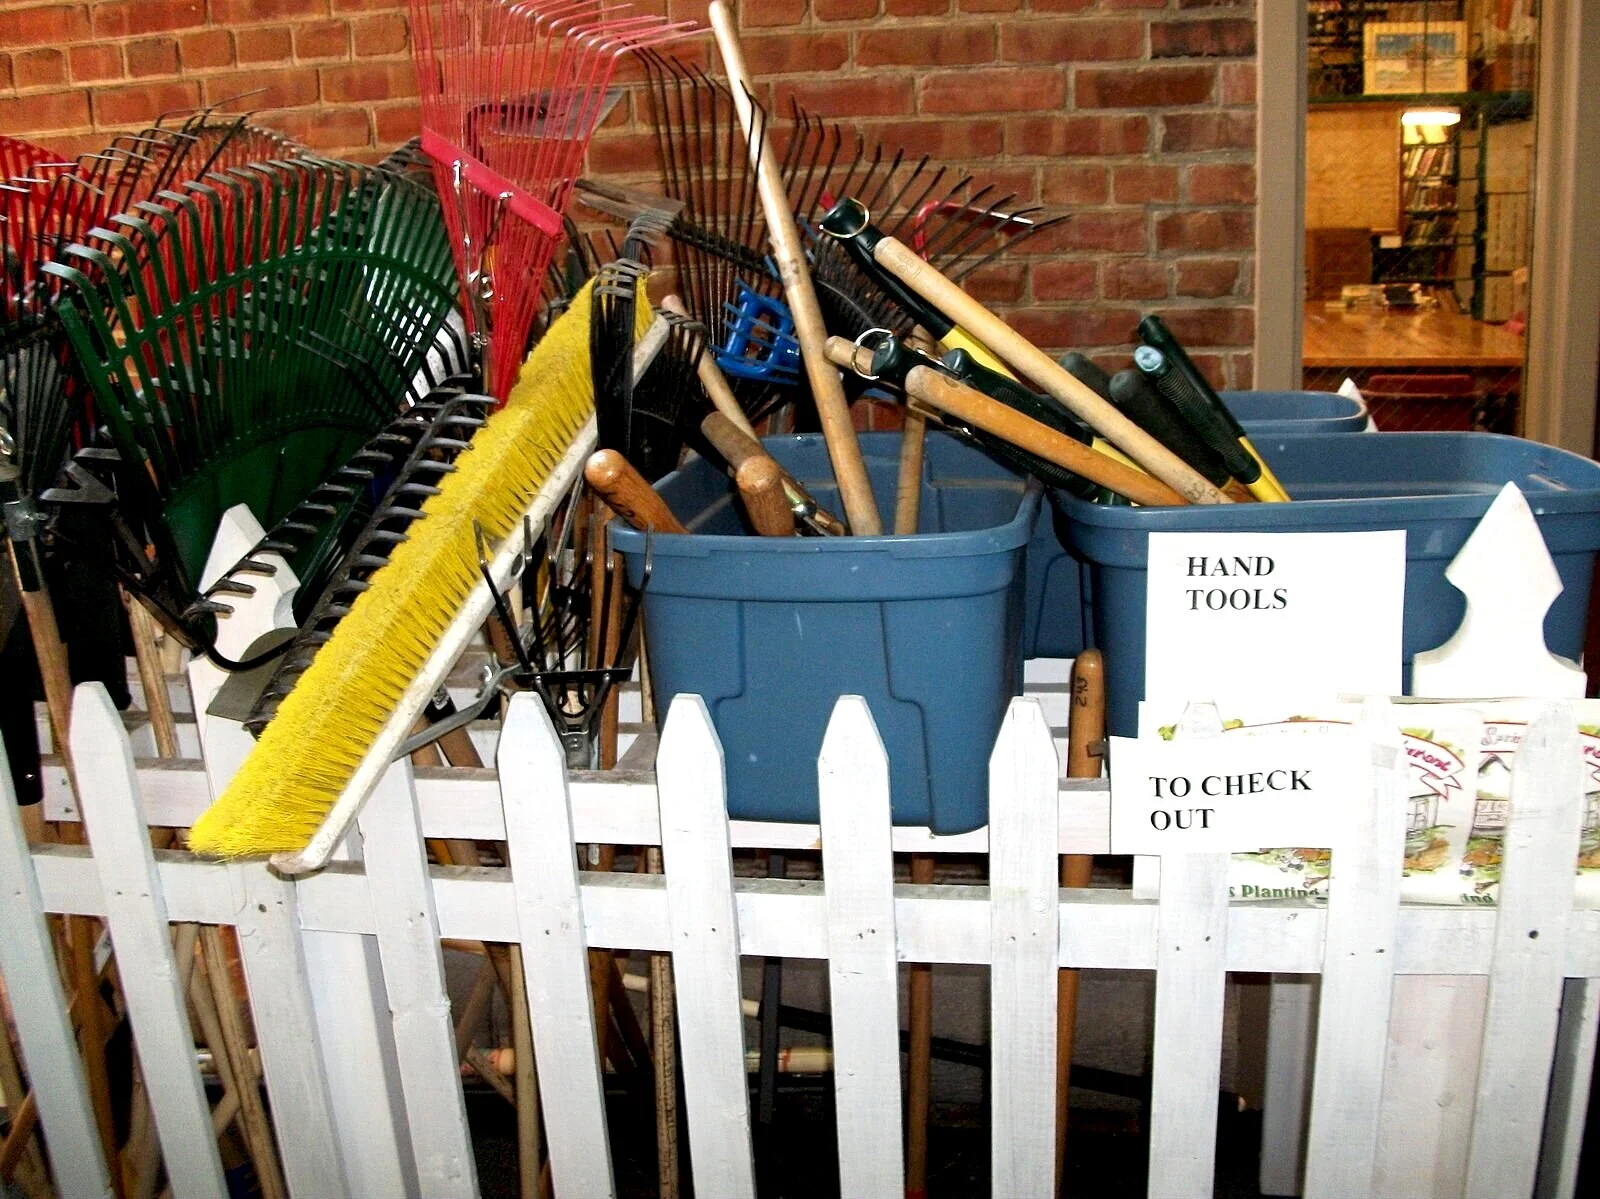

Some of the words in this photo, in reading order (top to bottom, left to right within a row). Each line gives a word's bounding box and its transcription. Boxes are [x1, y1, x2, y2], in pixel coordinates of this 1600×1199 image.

[1186, 556, 1275, 577] HAND
[1186, 588, 1288, 611] TOOLS
[1148, 776, 1192, 798] TO
[1201, 769, 1312, 797] CHECK
[1150, 808, 1215, 831] OUT
